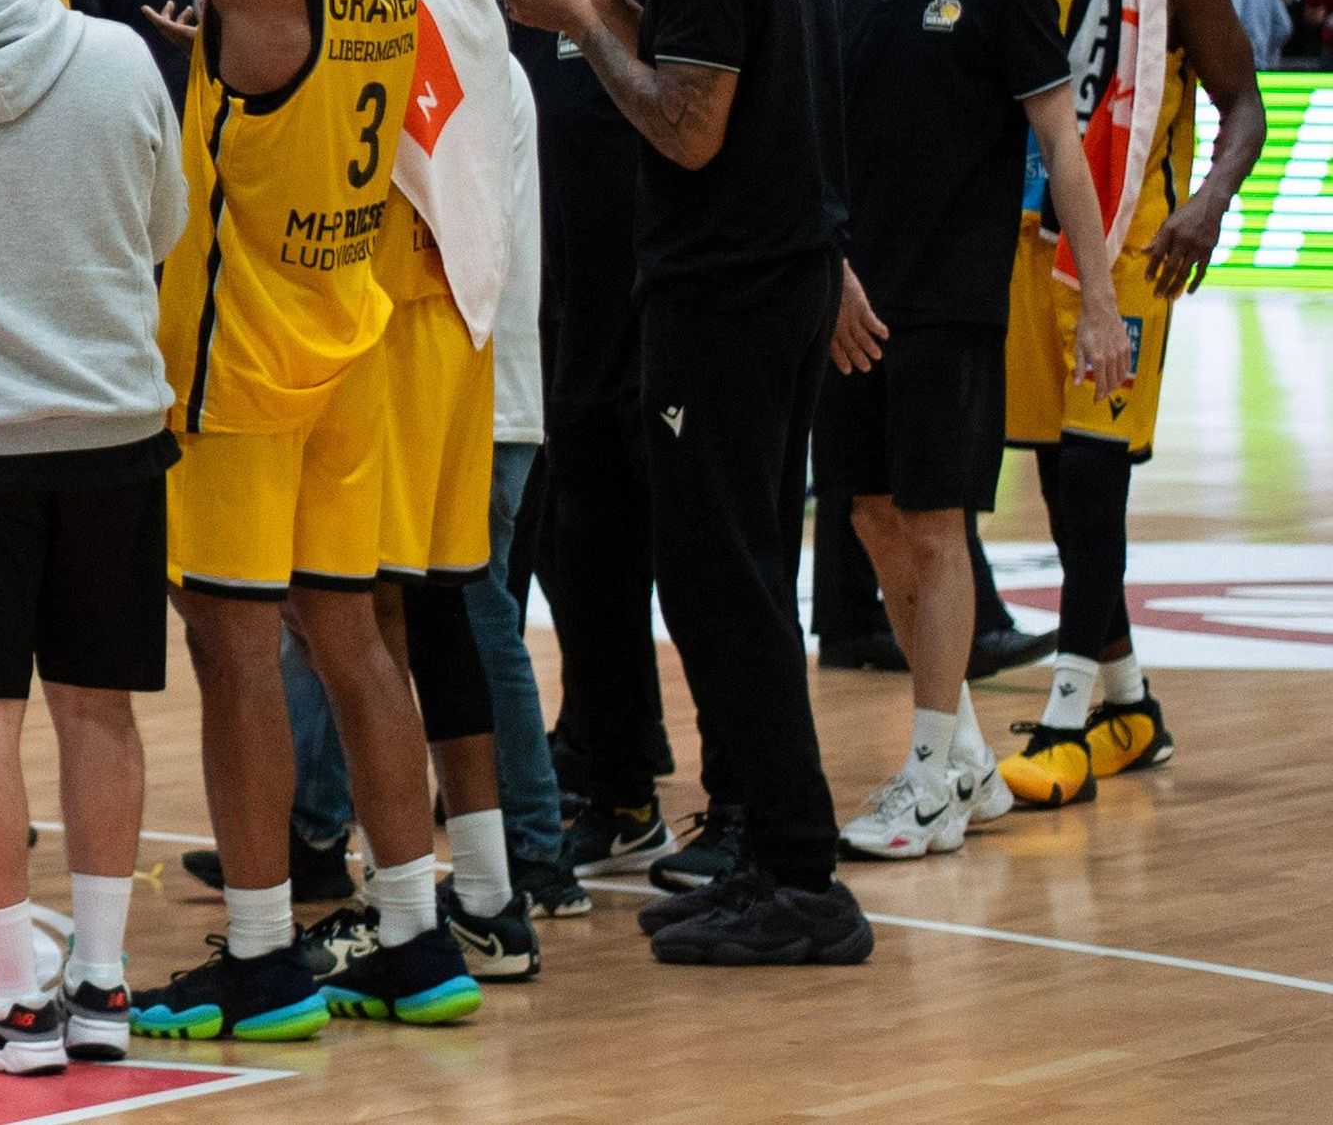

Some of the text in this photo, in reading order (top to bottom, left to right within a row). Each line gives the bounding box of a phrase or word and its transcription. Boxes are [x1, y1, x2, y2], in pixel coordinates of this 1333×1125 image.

[327, 32, 415, 62] LIBERMENTA
[347, 81, 387, 189] 3
[342, 200, 386, 239] RIESE
